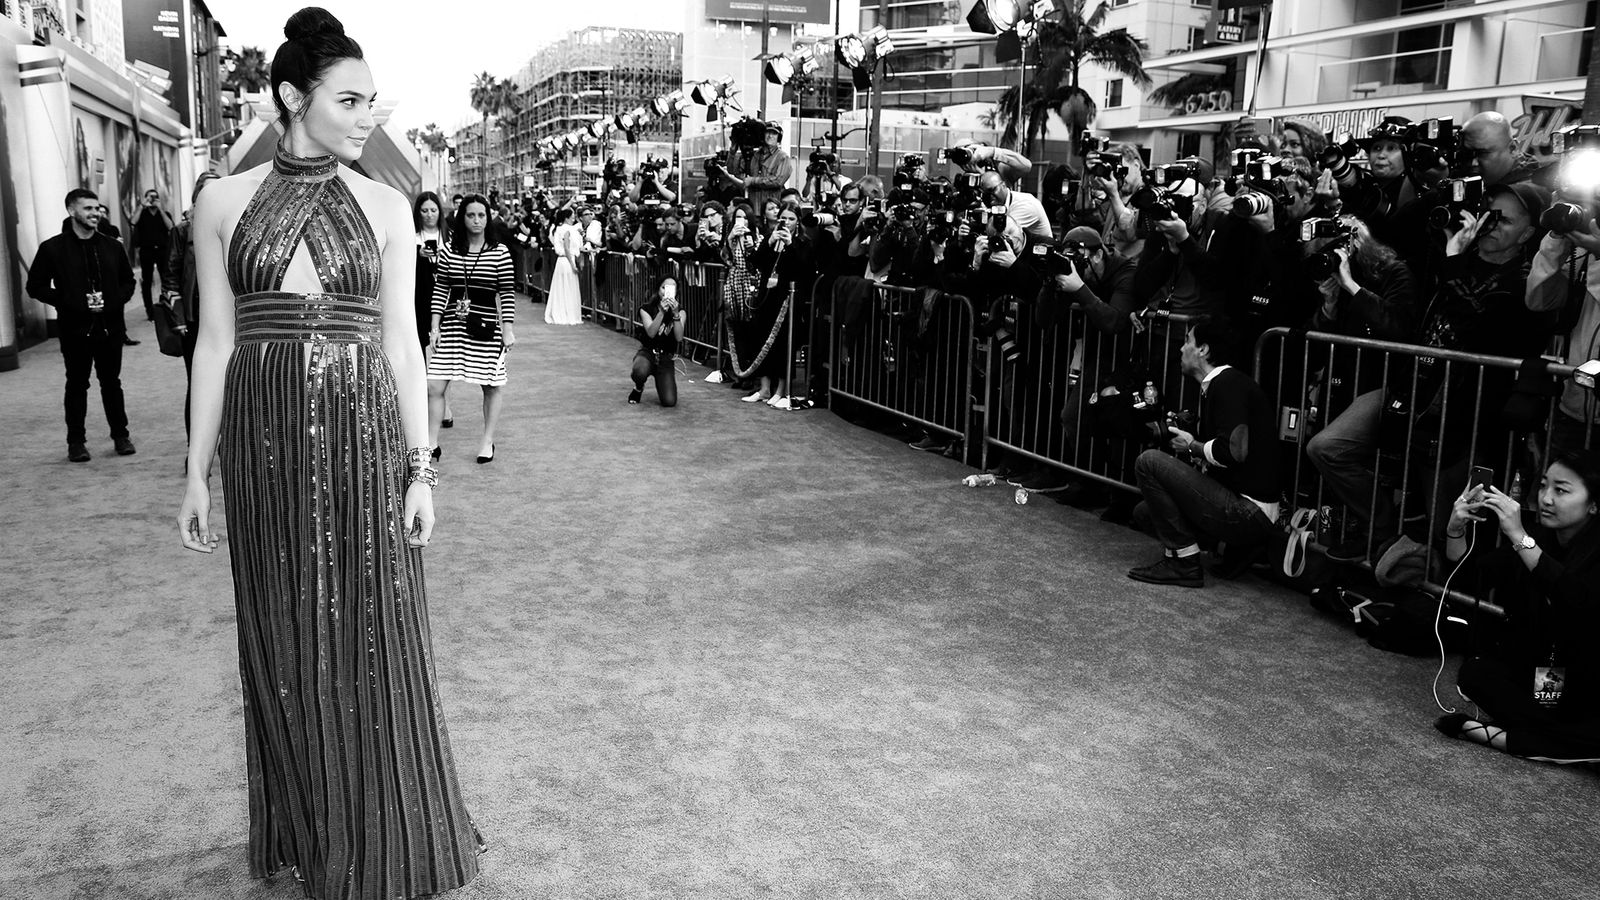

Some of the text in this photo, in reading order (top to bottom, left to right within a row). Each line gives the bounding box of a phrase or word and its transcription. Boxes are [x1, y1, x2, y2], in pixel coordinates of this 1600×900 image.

[1226, 32, 1239, 40] BAR
[1185, 90, 1231, 113] 6250
[1253, 295, 1269, 304] PRESS
[1534, 691, 1562, 699] STAFF
